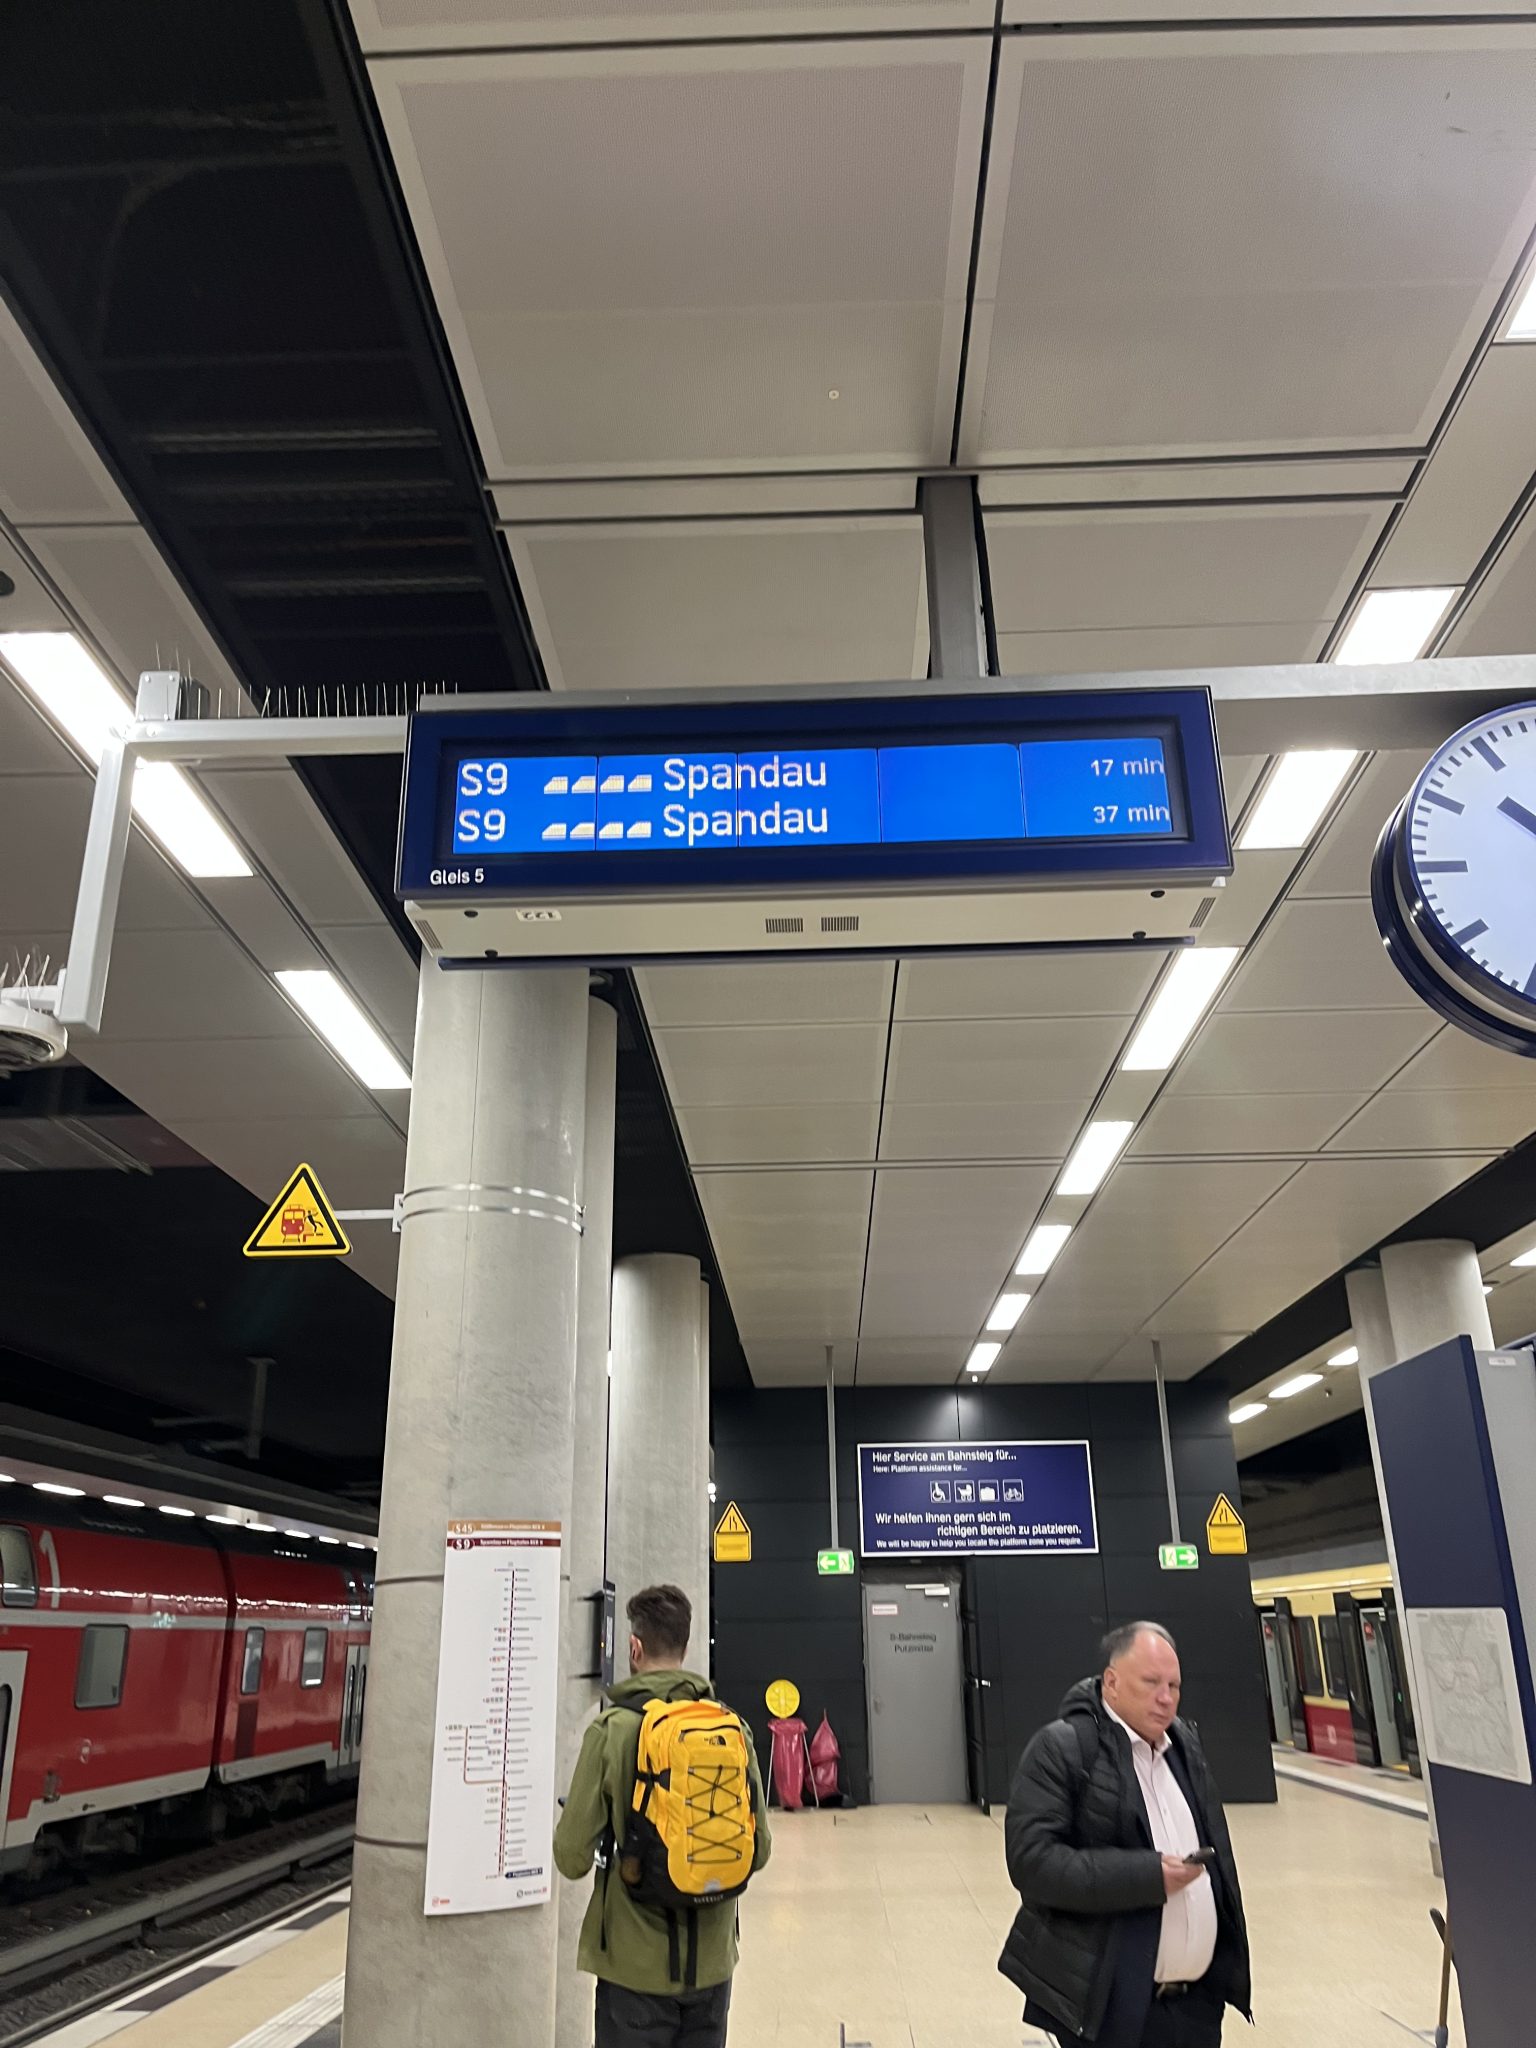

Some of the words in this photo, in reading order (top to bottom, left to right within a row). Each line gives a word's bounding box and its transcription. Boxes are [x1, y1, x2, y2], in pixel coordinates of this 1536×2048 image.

[460, 762, 508, 796] S9
[662, 755, 827, 799] Spandau
[1090, 758, 1114, 776] 17
[1123, 757, 1164, 775] min
[457, 808, 506, 843] S9
[662, 801, 828, 846] Spandau
[1093, 805, 1118, 824] 37
[1128, 804, 1170, 822] min
[430, 869, 470, 885] Gleis
[474, 868, 484, 883] 5
[873, 1451, 891, 1462] Hier
[893, 1451, 928, 1462] Service
[930, 1452, 945, 1461] am
[947, 1450, 994, 1462] Bahnsteig
[996, 1449, 1017, 1460] für...
[891, 1464, 918, 1473] Platform
[919, 1464, 952, 1472] assistance
[875, 1513, 891, 1524] Wir
[893, 1512, 923, 1524] helfen
[925, 1512, 951, 1523] Ihnen
[954, 1513, 975, 1525] gern
[977, 1511, 997, 1522] sich
[999, 1510, 1011, 1522] im
[937, 1524, 978, 1538] richtigen
[980, 1523, 1016, 1536] Bereich
[1018, 1525, 1030, 1535] zu
[1032, 1523, 1082, 1536] platzieren.
[910, 1539, 930, 1549] happy
[939, 1538, 954, 1548] help
[954, 1539, 966, 1548] you
[1000, 1537, 1028, 1547] platform
[1045, 1538, 1057, 1547] you
